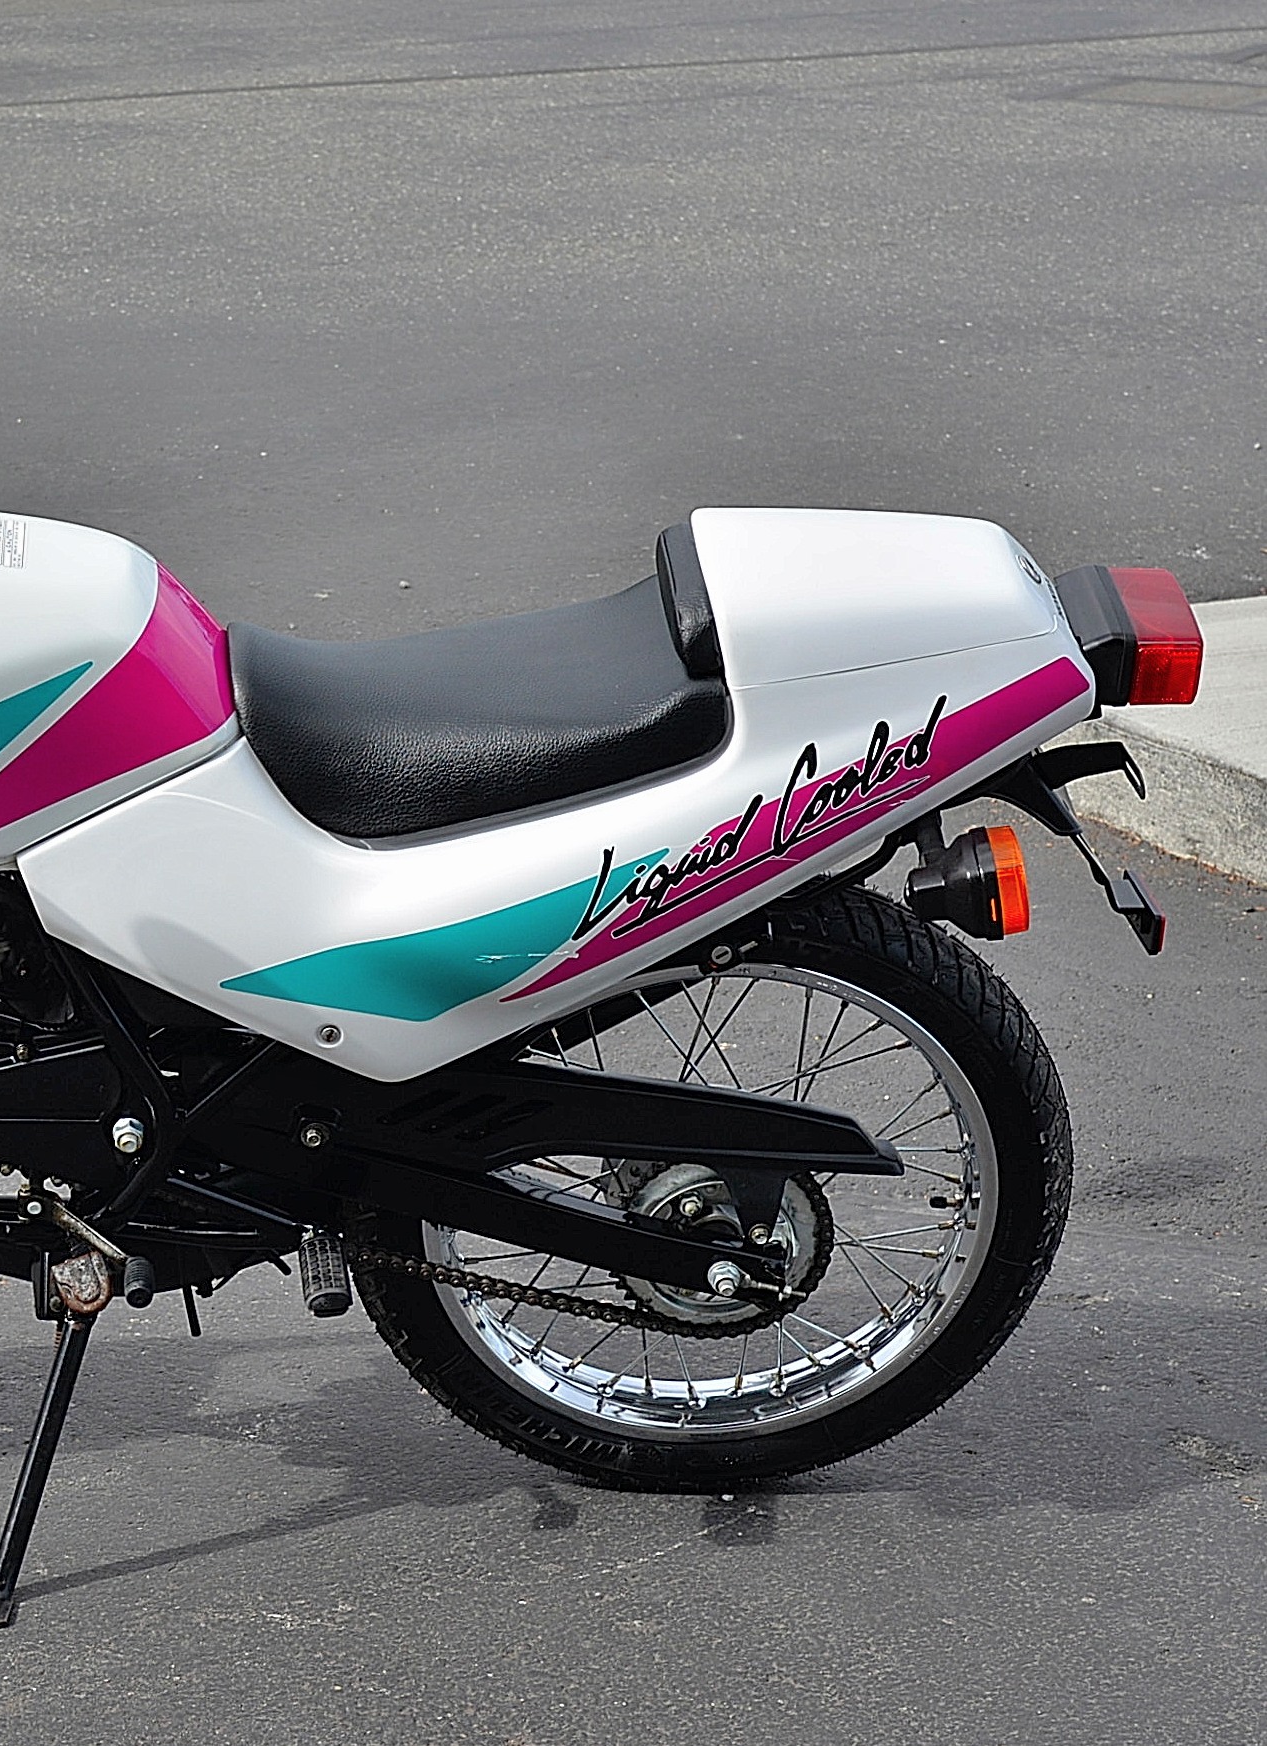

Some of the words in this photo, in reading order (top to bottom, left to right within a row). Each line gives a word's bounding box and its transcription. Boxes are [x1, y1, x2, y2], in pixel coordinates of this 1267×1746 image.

[572, 794, 764, 939] Liquid
[772, 695, 948, 857] Cooled
[451, 1369, 622, 1456] MICHE
